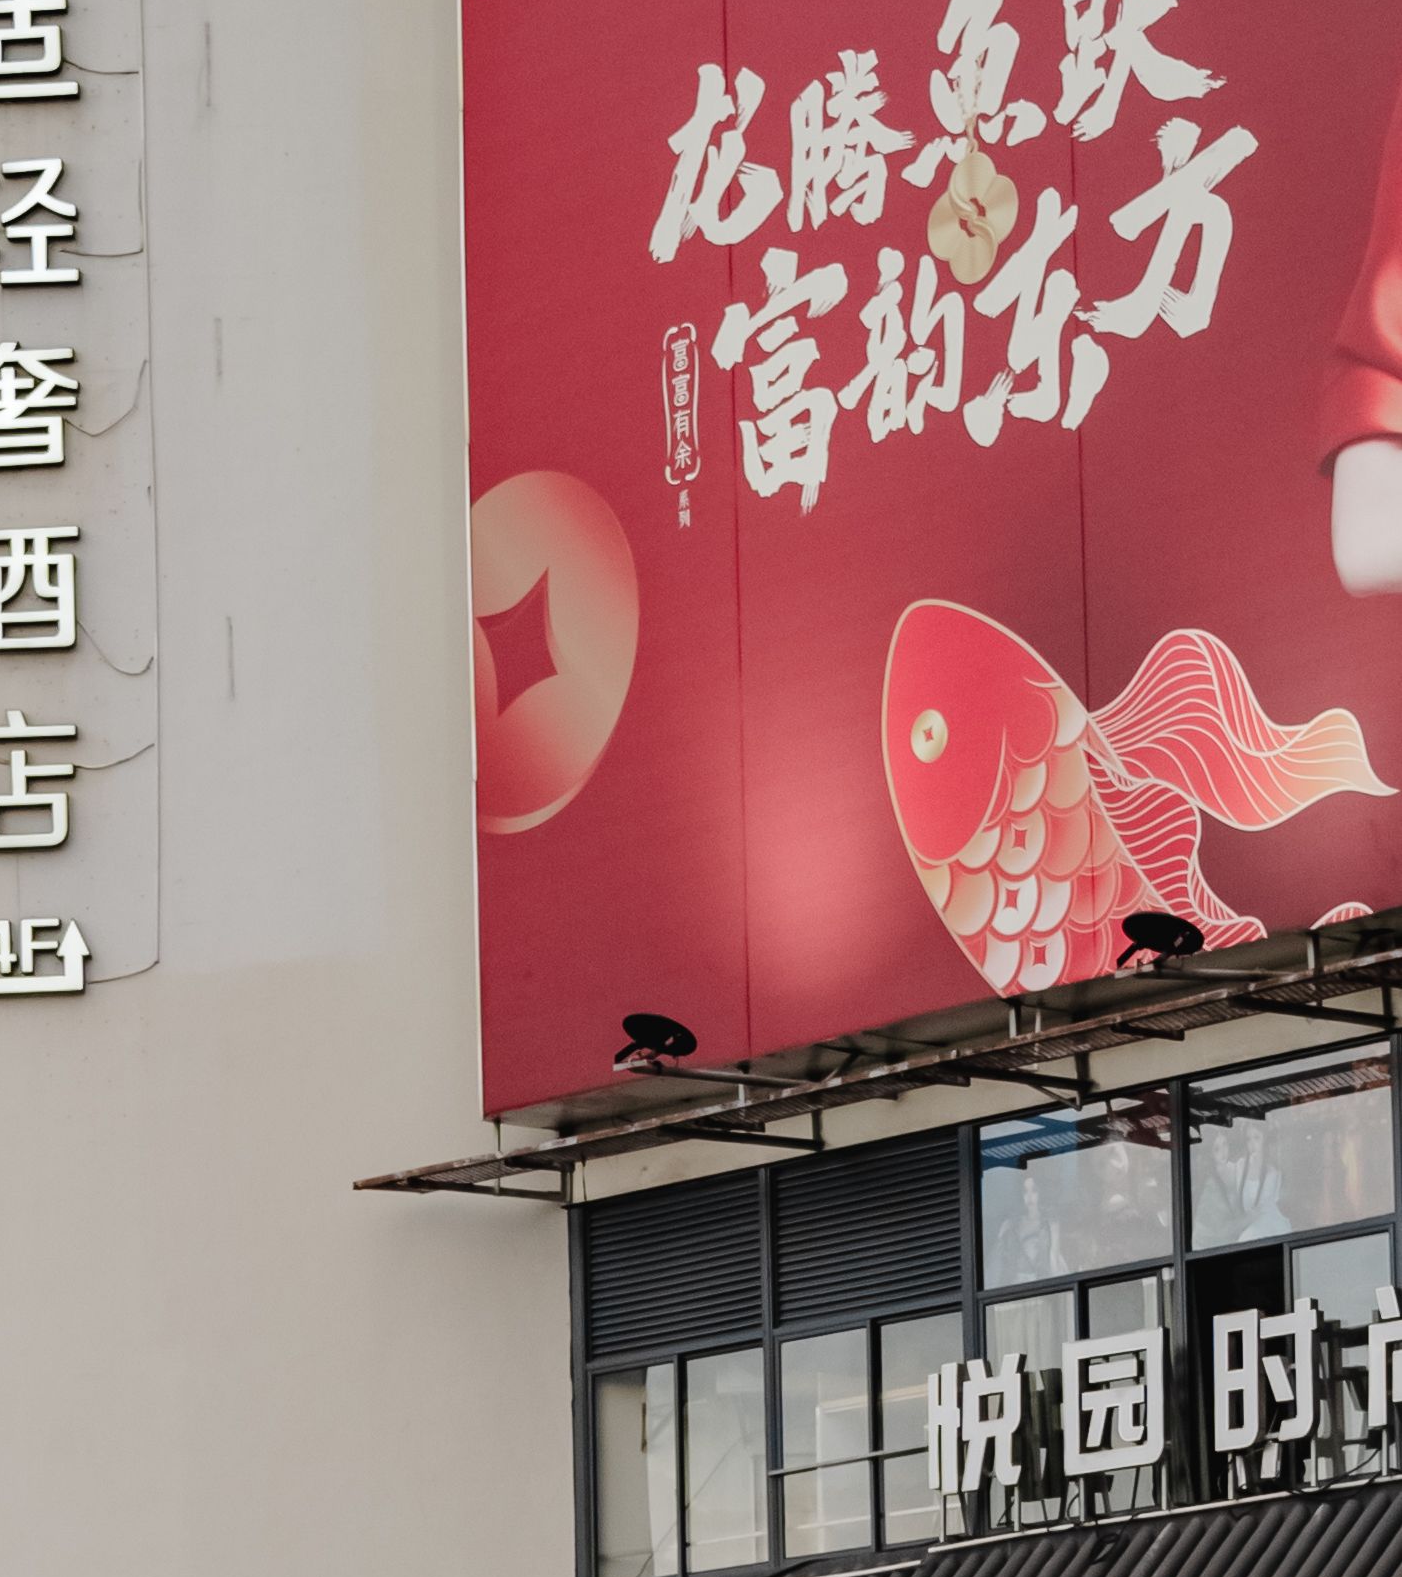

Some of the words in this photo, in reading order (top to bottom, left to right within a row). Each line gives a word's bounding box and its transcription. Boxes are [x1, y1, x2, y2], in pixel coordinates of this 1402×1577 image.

[671, 339, 692, 470] 富富有余
[678, 489, 691, 529] 系列
